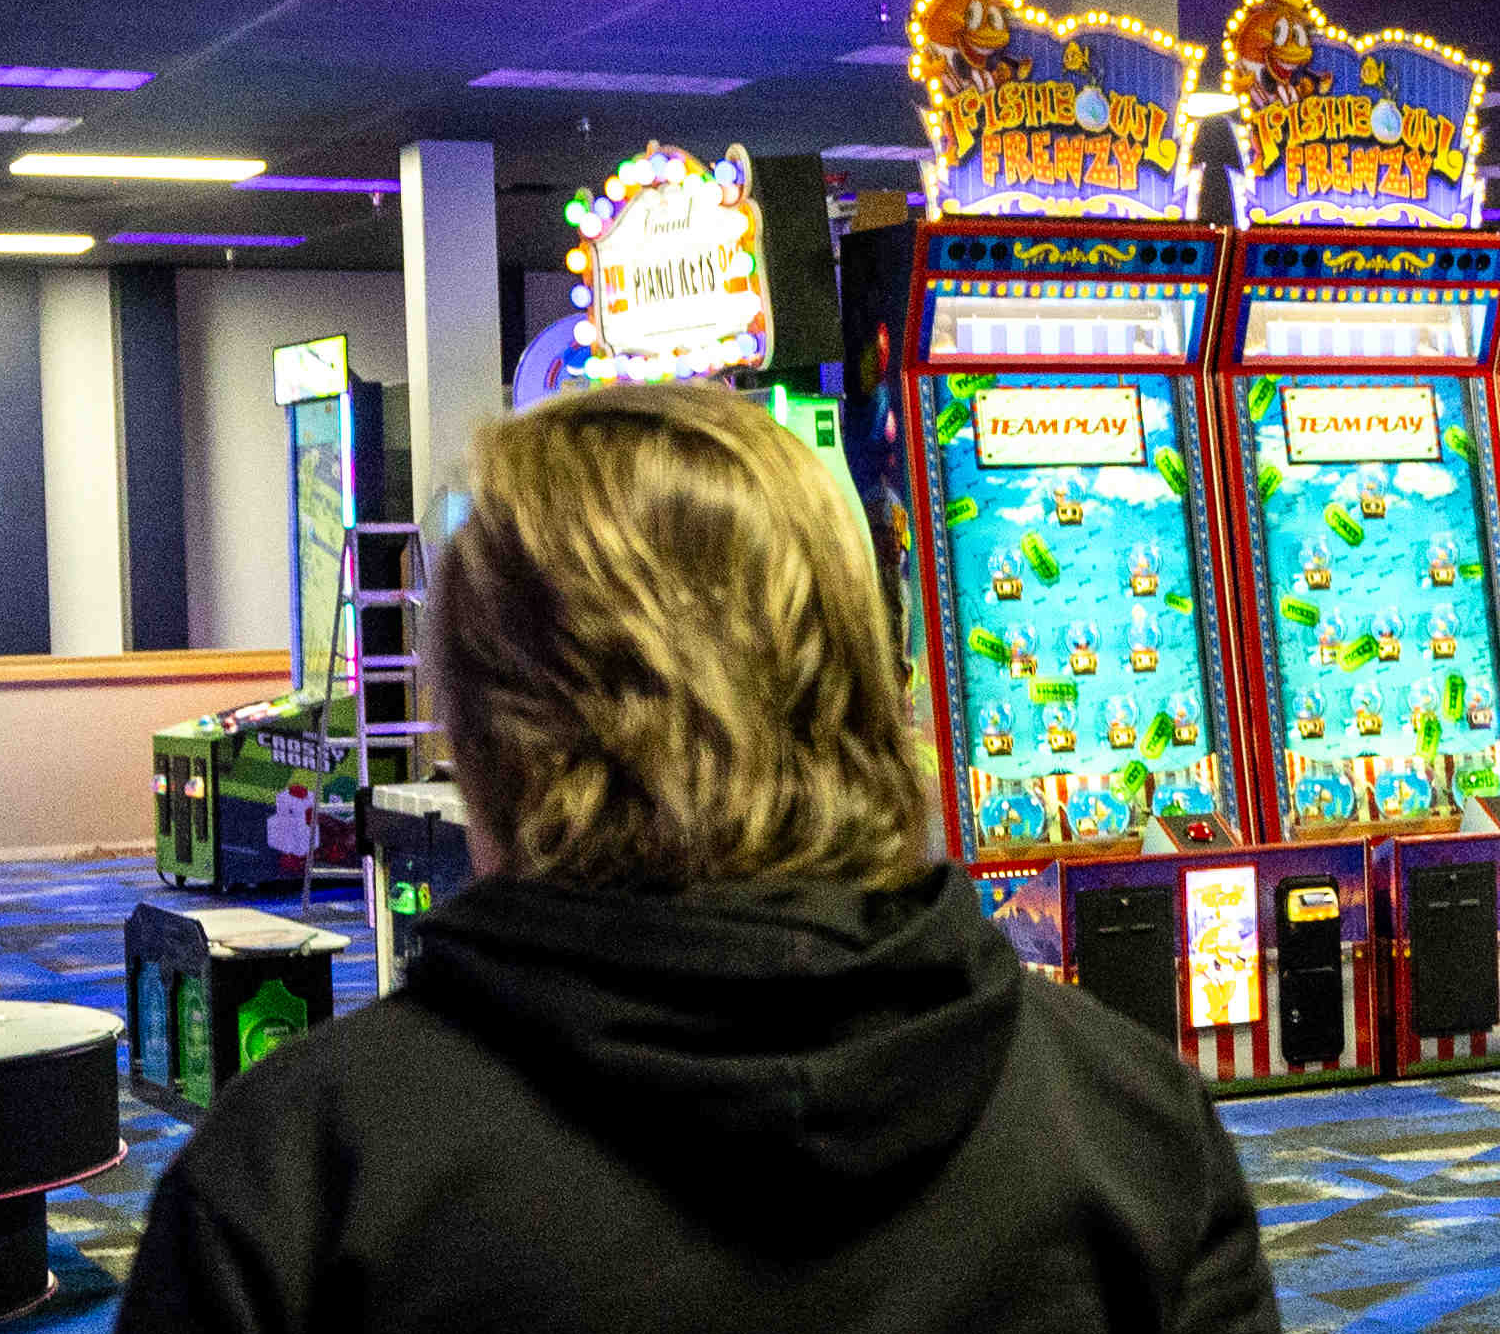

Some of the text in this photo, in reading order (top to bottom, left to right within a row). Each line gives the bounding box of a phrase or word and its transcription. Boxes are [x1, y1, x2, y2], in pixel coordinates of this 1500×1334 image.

[946, 79, 1177, 172] FISHBOWL
[1252, 94, 1464, 181] FISHBOWL
[981, 131, 1143, 190] FRENZY
[1286, 143, 1432, 199] FRENZY
[990, 417, 1128, 435] TEAM PLAY
[1298, 416, 1424, 434] TEAM PLAY
